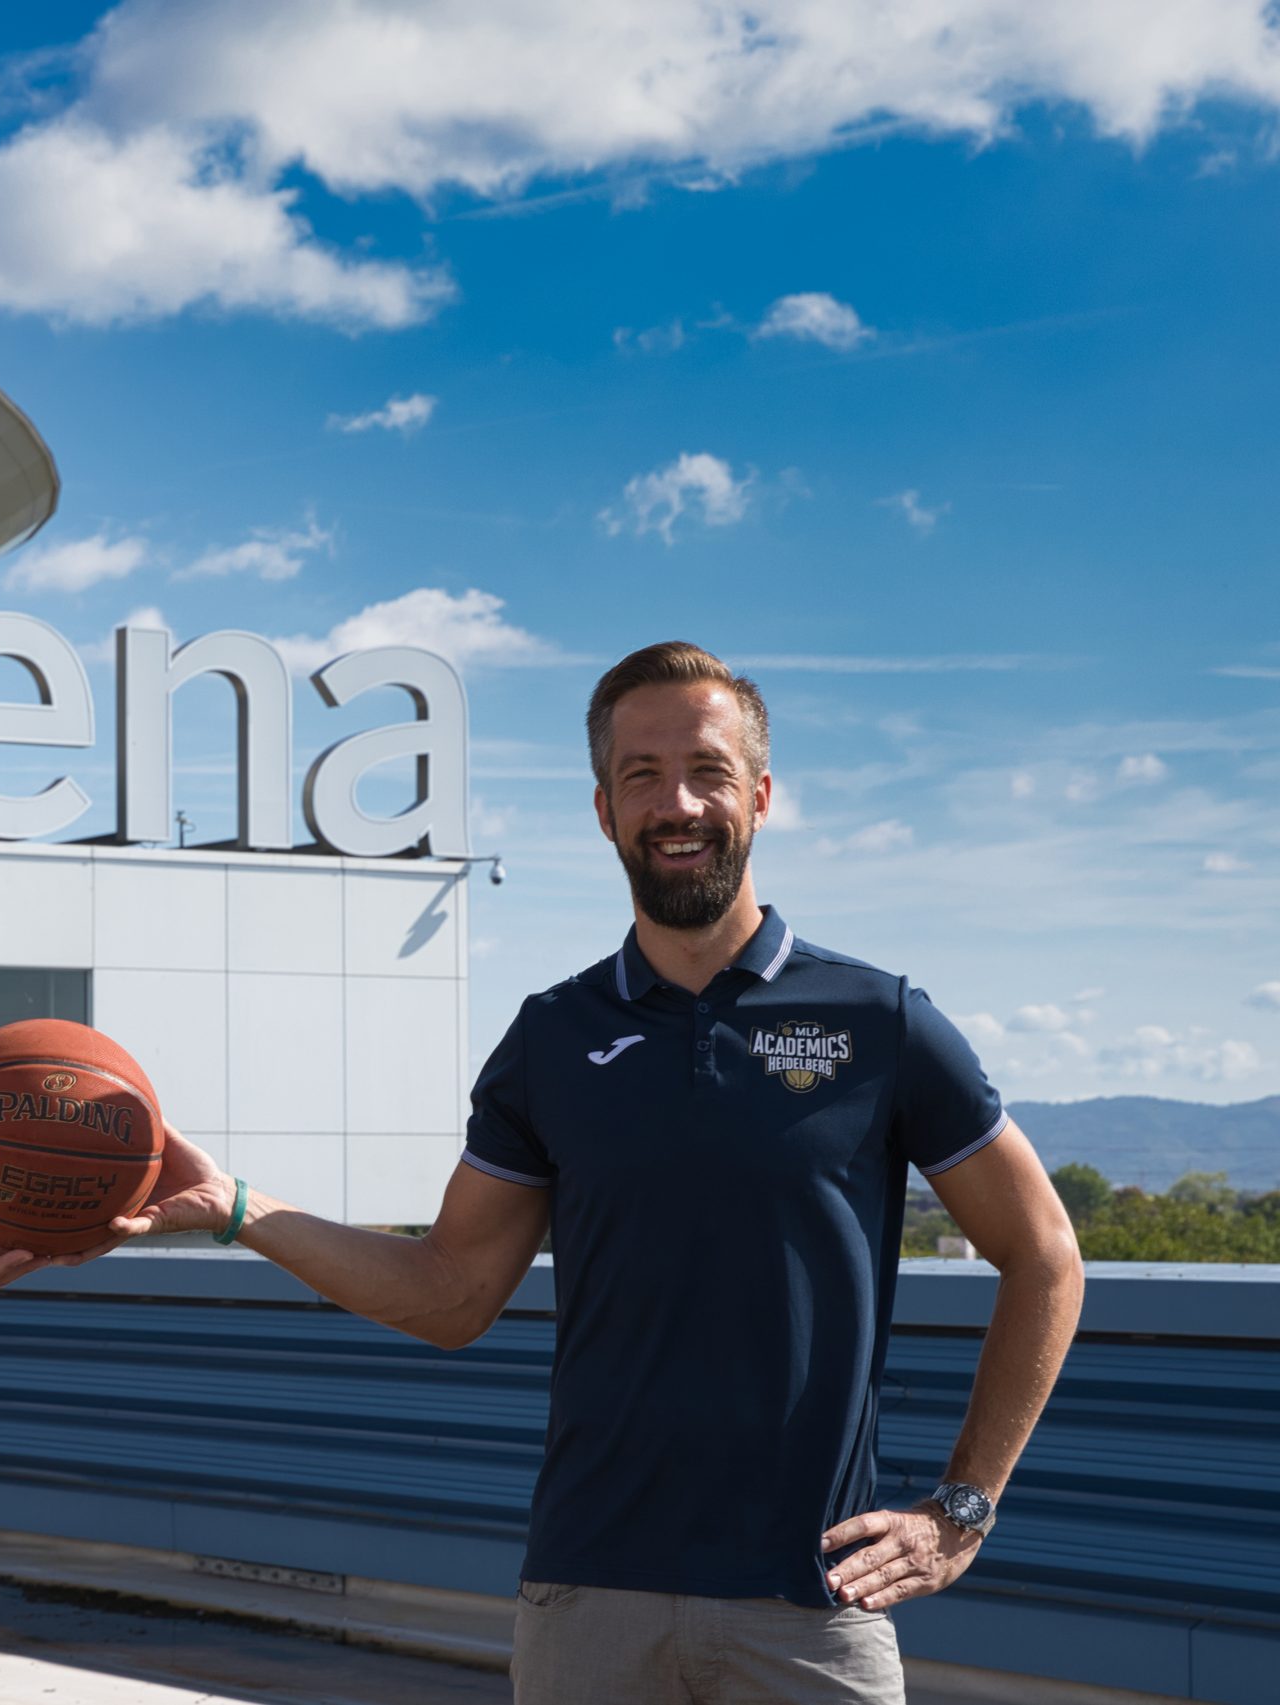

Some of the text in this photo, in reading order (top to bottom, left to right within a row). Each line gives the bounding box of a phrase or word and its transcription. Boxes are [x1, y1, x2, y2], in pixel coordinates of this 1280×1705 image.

[795, 1027, 820, 1037] MLP
[752, 1031, 849, 1060] ACADEMICS
[767, 1056, 833, 1076] HEIDELBERG
